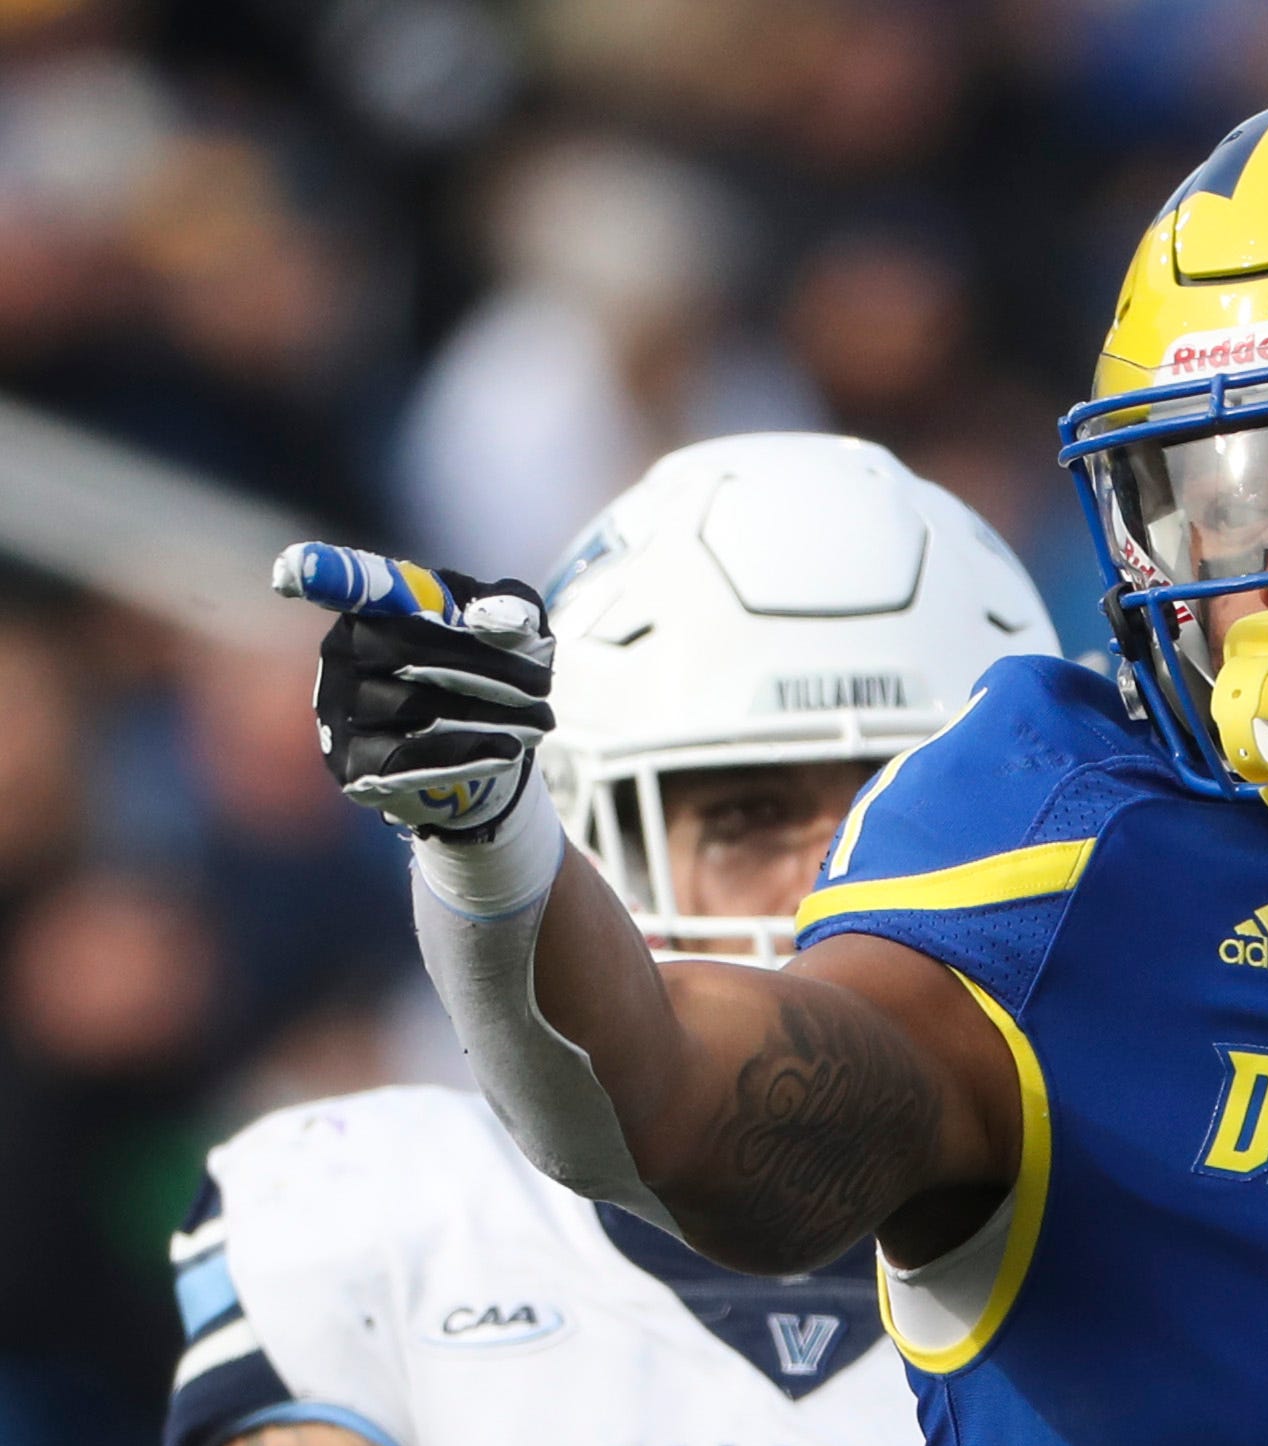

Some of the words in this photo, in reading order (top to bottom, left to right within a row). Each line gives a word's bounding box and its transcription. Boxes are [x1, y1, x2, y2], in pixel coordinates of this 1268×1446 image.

[775, 673, 908, 711] VILLANOVA
[442, 1303, 539, 1335] CAA
[767, 1312, 841, 1376] V
